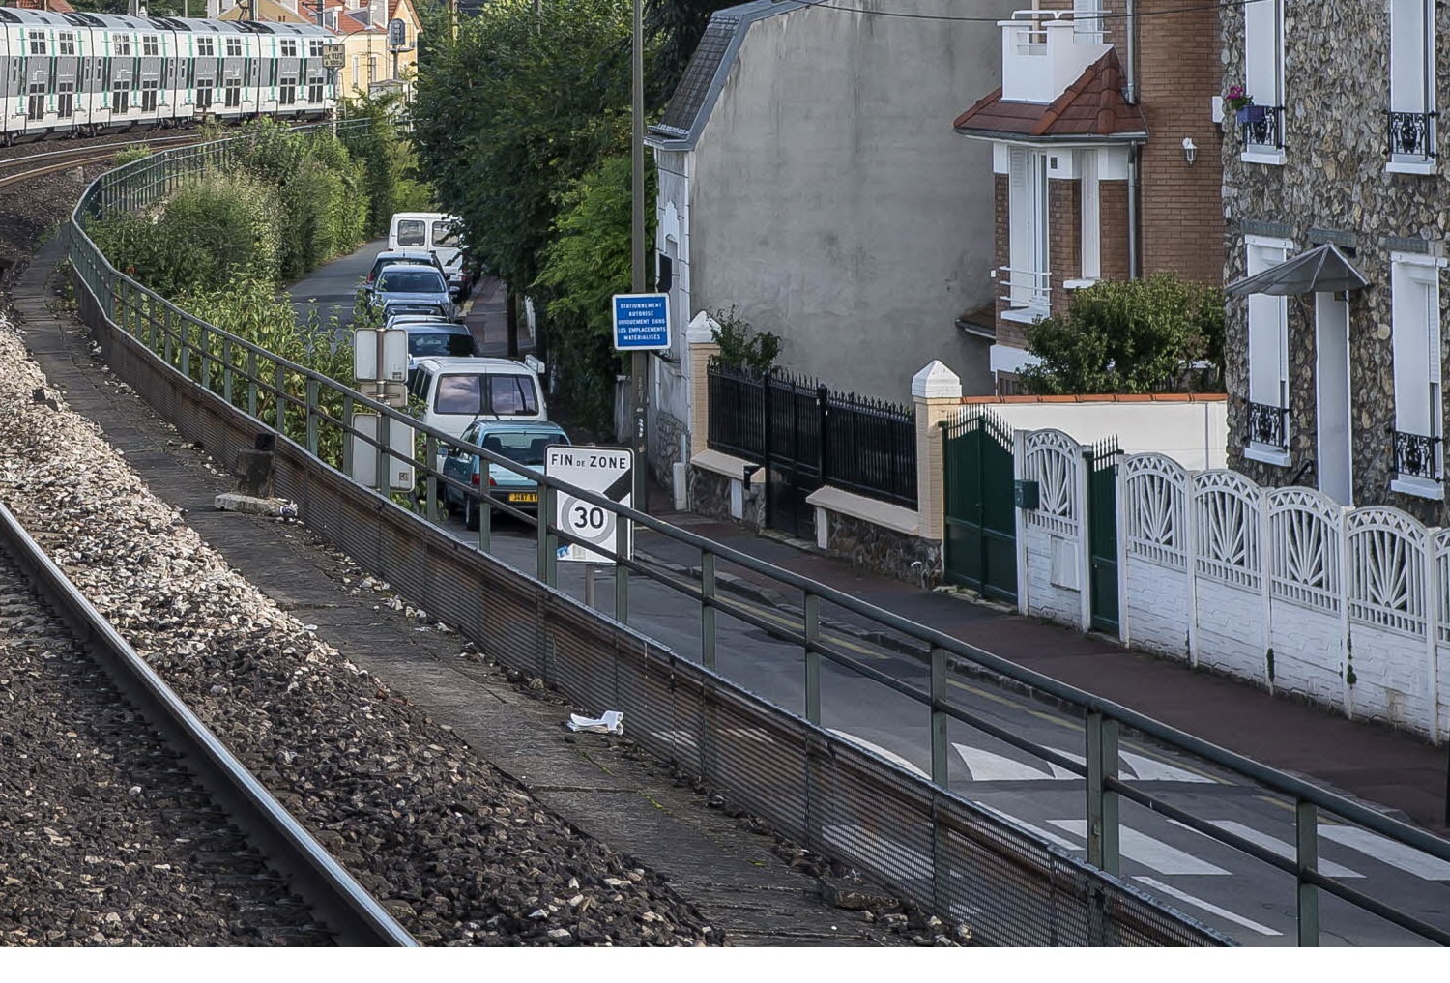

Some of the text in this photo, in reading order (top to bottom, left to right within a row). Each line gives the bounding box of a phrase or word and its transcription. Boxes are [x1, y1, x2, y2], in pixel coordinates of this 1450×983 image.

[628, 326, 667, 334] EMPLACEMENTS
[551, 453, 573, 466] FIN
[590, 456, 626, 469] ZONE
[573, 506, 604, 529] 30
